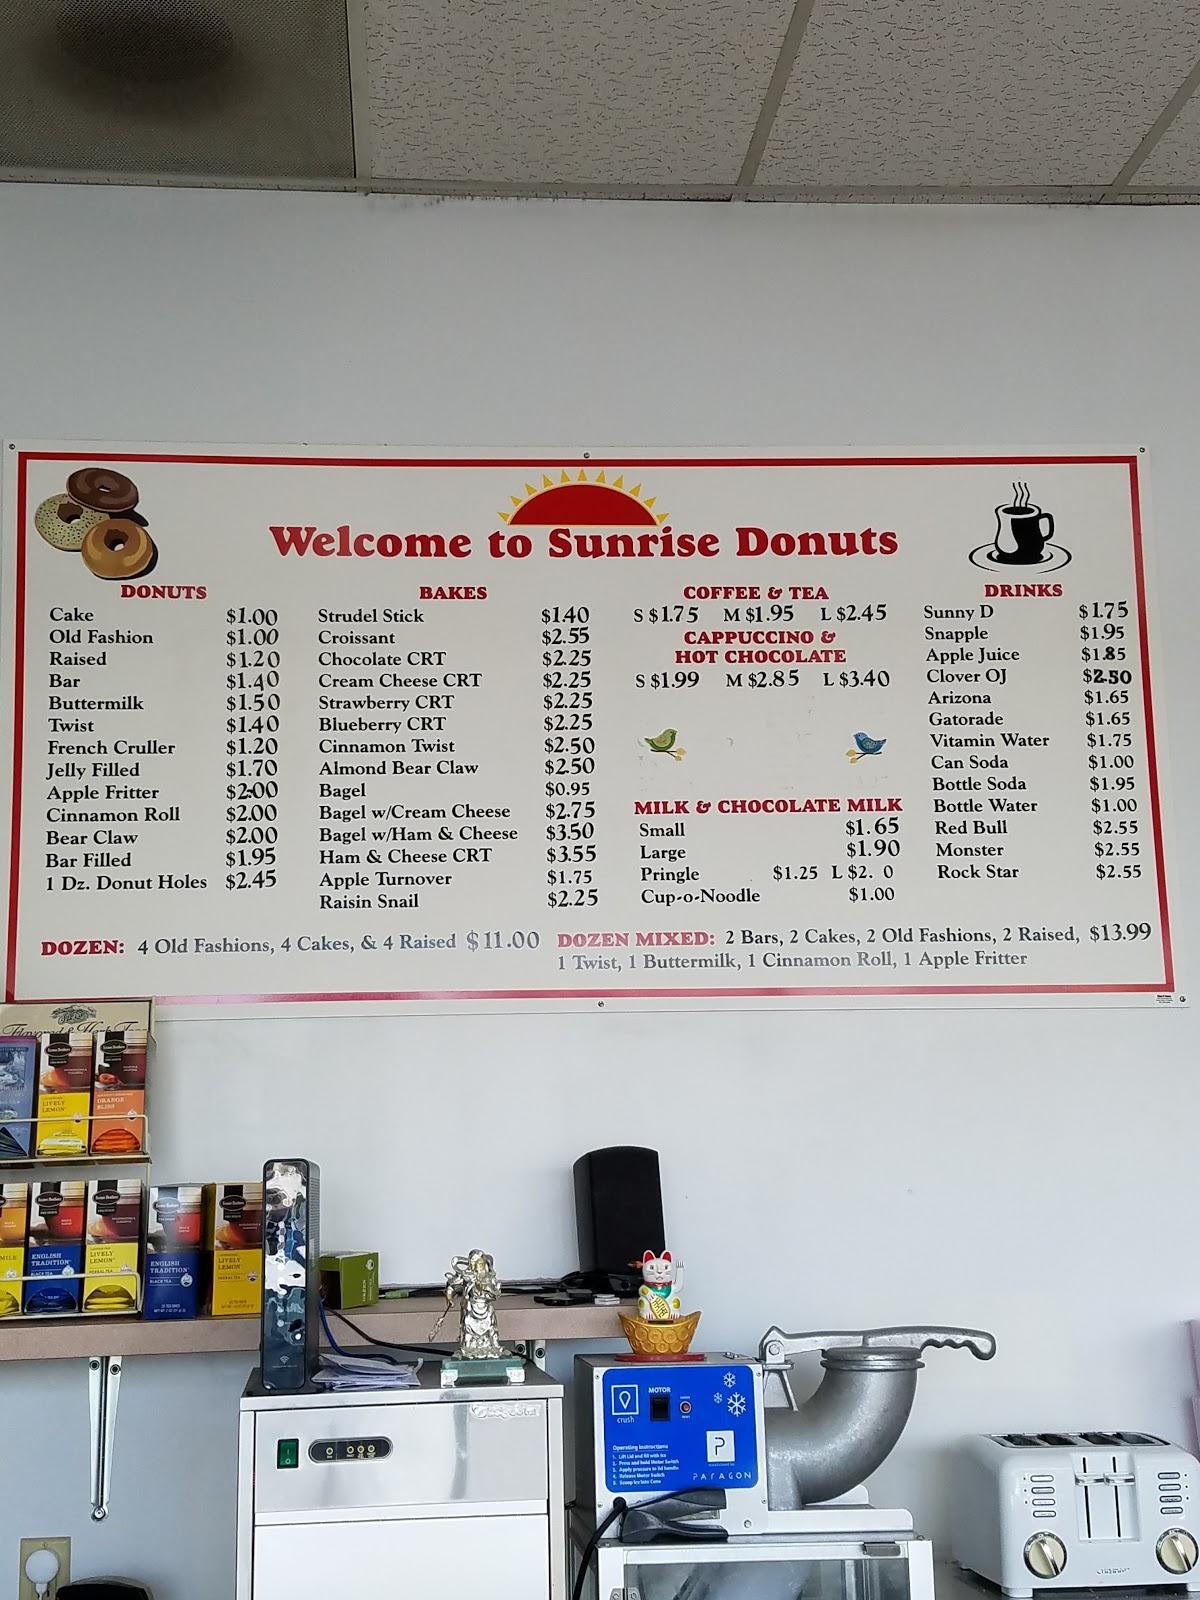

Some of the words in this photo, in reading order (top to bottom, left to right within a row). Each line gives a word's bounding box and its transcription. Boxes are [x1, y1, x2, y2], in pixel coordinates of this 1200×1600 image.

[269, 525, 471, 558] Welcome
[488, 531, 532, 558] to
[549, 526, 719, 558] Sunrise
[736, 527, 898, 556] Donuts
[121, 585, 206, 599] DONUTS
[420, 587, 487, 600] BAKES
[684, 586, 760, 599] COFFEE
[768, 587, 782, 599] &
[789, 587, 829, 599] TEA
[984, 584, 1062, 597] DRINKS
[50, 607, 93, 621] Cake
[227, 607, 277, 626] $1.00
[634, 609, 643, 622] S
[649, 605, 698, 624] $1.75
[724, 608, 740, 621] M
[746, 605, 793, 623] $1.95
[821, 608, 831, 621] L
[837, 604, 886, 623] $2.45
[50, 629, 81, 643] Old
[88, 630, 153, 644] Fashion
[227, 628, 279, 647] $1.00
[319, 631, 395, 644] Croissant
[542, 626, 589, 646] $2.55
[684, 631, 814, 644] CAPPUCCINO
[821, 631, 836, 643] &
[319, 652, 401, 666] Chocolate
[407, 652, 446, 665] CRT
[543, 650, 591, 668] $2.25
[675, 651, 718, 663] HOT
[725, 650, 846, 663] CHOCOLATE
[926, 647, 973, 664] Apple
[978, 648, 1019, 664] Juice
[1082, 646, 1125, 663] $1.85
[636, 674, 645, 688] S
[651, 671, 699, 690] $1.99
[726, 674, 742, 687] M
[748, 669, 799, 689] $2.85
[823, 673, 834, 686] L
[840, 669, 889, 688] $3.40
[927, 669, 980, 683] Clover
[986, 669, 1006, 685] OJ
[1083, 668, 1132, 684] $2.50
[49, 696, 144, 710] Buttermilk
[227, 693, 280, 712] $1.50
[319, 695, 410, 712] Strawberry
[415, 695, 454, 709] CRT
[544, 692, 592, 711] $2.25
[928, 691, 991, 704] Arizona
[1084, 689, 1128, 706] $1.65
[48, 740, 108, 754] French
[114, 740, 175, 754] Cruller
[227, 738, 278, 756] $1.20
[930, 734, 995, 747] Vitamin
[1000, 733, 1049, 746] Water
[1087, 732, 1131, 749] $1.75
[46, 763, 86, 780] Jelly
[92, 762, 139, 777] Filled
[227, 759, 277, 779] $1.70
[319, 761, 386, 775] Almond
[392, 761, 431, 774] Bear
[437, 760, 478, 774] Claw
[545, 757, 595, 776] $2.50
[47, 808, 138, 822] Cinnamon
[144, 807, 180, 821] Roll
[226, 804, 277, 823] $2.00
[319, 805, 366, 822] Bagel
[372, 805, 446, 820] w/Cream
[452, 804, 510, 818] Cheese
[546, 801, 595, 820] $2.75
[634, 801, 690, 814] MILK
[696, 801, 711, 814] &
[718, 799, 840, 813] CHOCOLATE
[847, 798, 903, 812] MILK
[640, 823, 685, 837] Small
[846, 816, 899, 837] $1.65
[935, 820, 967, 834] Red
[973, 820, 1008, 834] Bull
[1093, 820, 1138, 836] $2.55
[320, 850, 360, 864] Ham
[367, 850, 382, 863] &
[388, 849, 447, 863] Cheese
[453, 848, 492, 862] CRT
[547, 845, 596, 864] $3.55
[640, 845, 686, 862] Large
[847, 839, 900, 859] $1.90
[47, 877, 53, 890] 1
[62, 876, 90, 890] Dz.
[97, 876, 153, 890] Donut
[158, 874, 207, 889] Holes
[226, 869, 276, 891] $2.45
[937, 864, 981, 878] Rock
[987, 864, 1019, 878] Star
[1096, 863, 1141, 880] $2.55
[320, 895, 372, 909] Raisin
[378, 893, 419, 908] Snail
[548, 889, 598, 908] $2.25
[641, 888, 760, 906] Cup-o-Noodle
[849, 886, 894, 903] $1.00
[41, 940, 124, 955] DOZEN:
[138, 940, 148, 955] 4
[155, 938, 188, 953] Old
[194, 938, 274, 955] Fashions,
[281, 937, 291, 952] 4
[298, 936, 354, 953] Cakes,
[361, 936, 377, 950] &
[383, 935, 393, 949] 4
[400, 933, 457, 949] Raised
[467, 931, 540, 952] $11.00
[558, 933, 629, 947] DOZEN
[636, 932, 714, 946] MIXED:
[726, 931, 734, 944] 2
[741, 930, 783, 947] Bars,
[790, 930, 798, 943] 2
[805, 929, 860, 946] Cakes,
[867, 929, 875, 942] 2
[882, 928, 913, 942] Old
[919, 928, 996, 944] Fashions,
[1003, 928, 1011, 941] 2
[1018, 926, 1079, 944] Raised,
[1090, 923, 1151, 943] $13.99
[617, 1416, 634, 1424] crush
